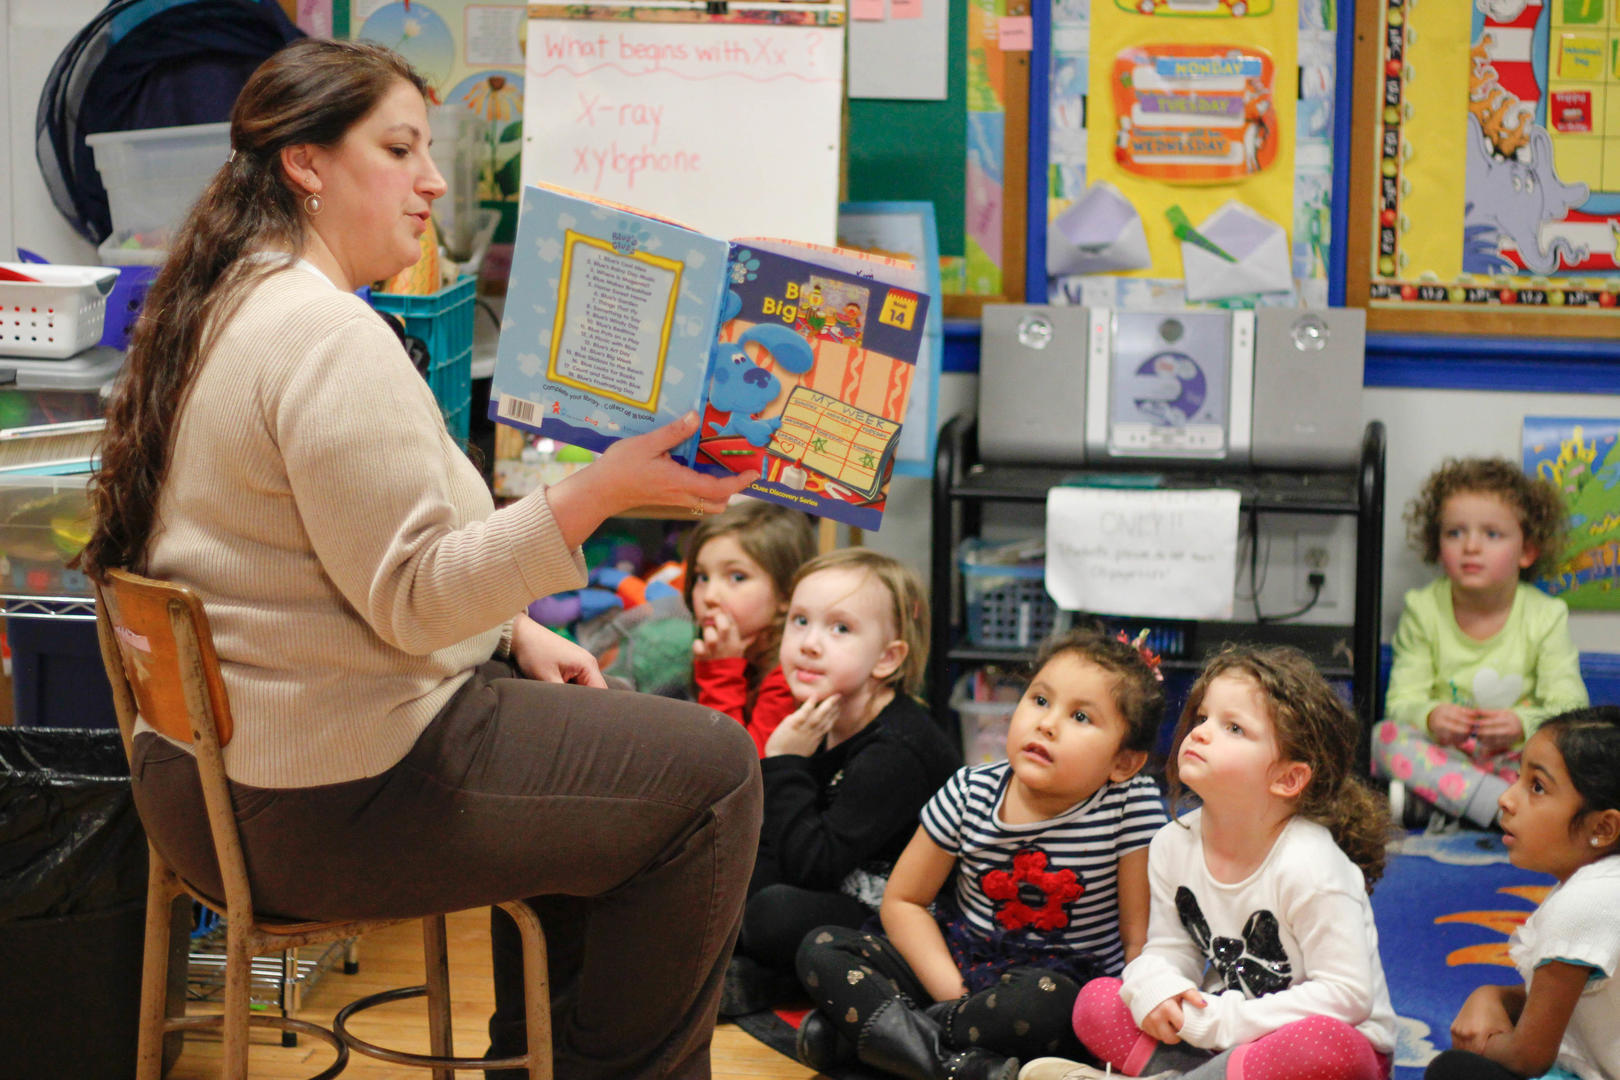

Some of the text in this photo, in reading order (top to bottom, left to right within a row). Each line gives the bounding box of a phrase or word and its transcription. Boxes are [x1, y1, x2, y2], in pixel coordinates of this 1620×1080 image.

[545, 33, 608, 58] What
[619, 34, 688, 68] begins
[698, 40, 750, 63] with
[1175, 61, 1243, 75] MONDAY
[1157, 98, 1229, 113] TUESDAY
[575, 91, 664, 144] X-ray
[1133, 140, 1225, 152] WEDNESDAY
[762, 297, 798, 324] Big
[890, 309, 905, 325] 14
[543, 383, 569, 397] Complete
[811, 394, 885, 430] MY WEEK
[769, 488, 798, 502] Discovery
[799, 496, 818, 507] Series
